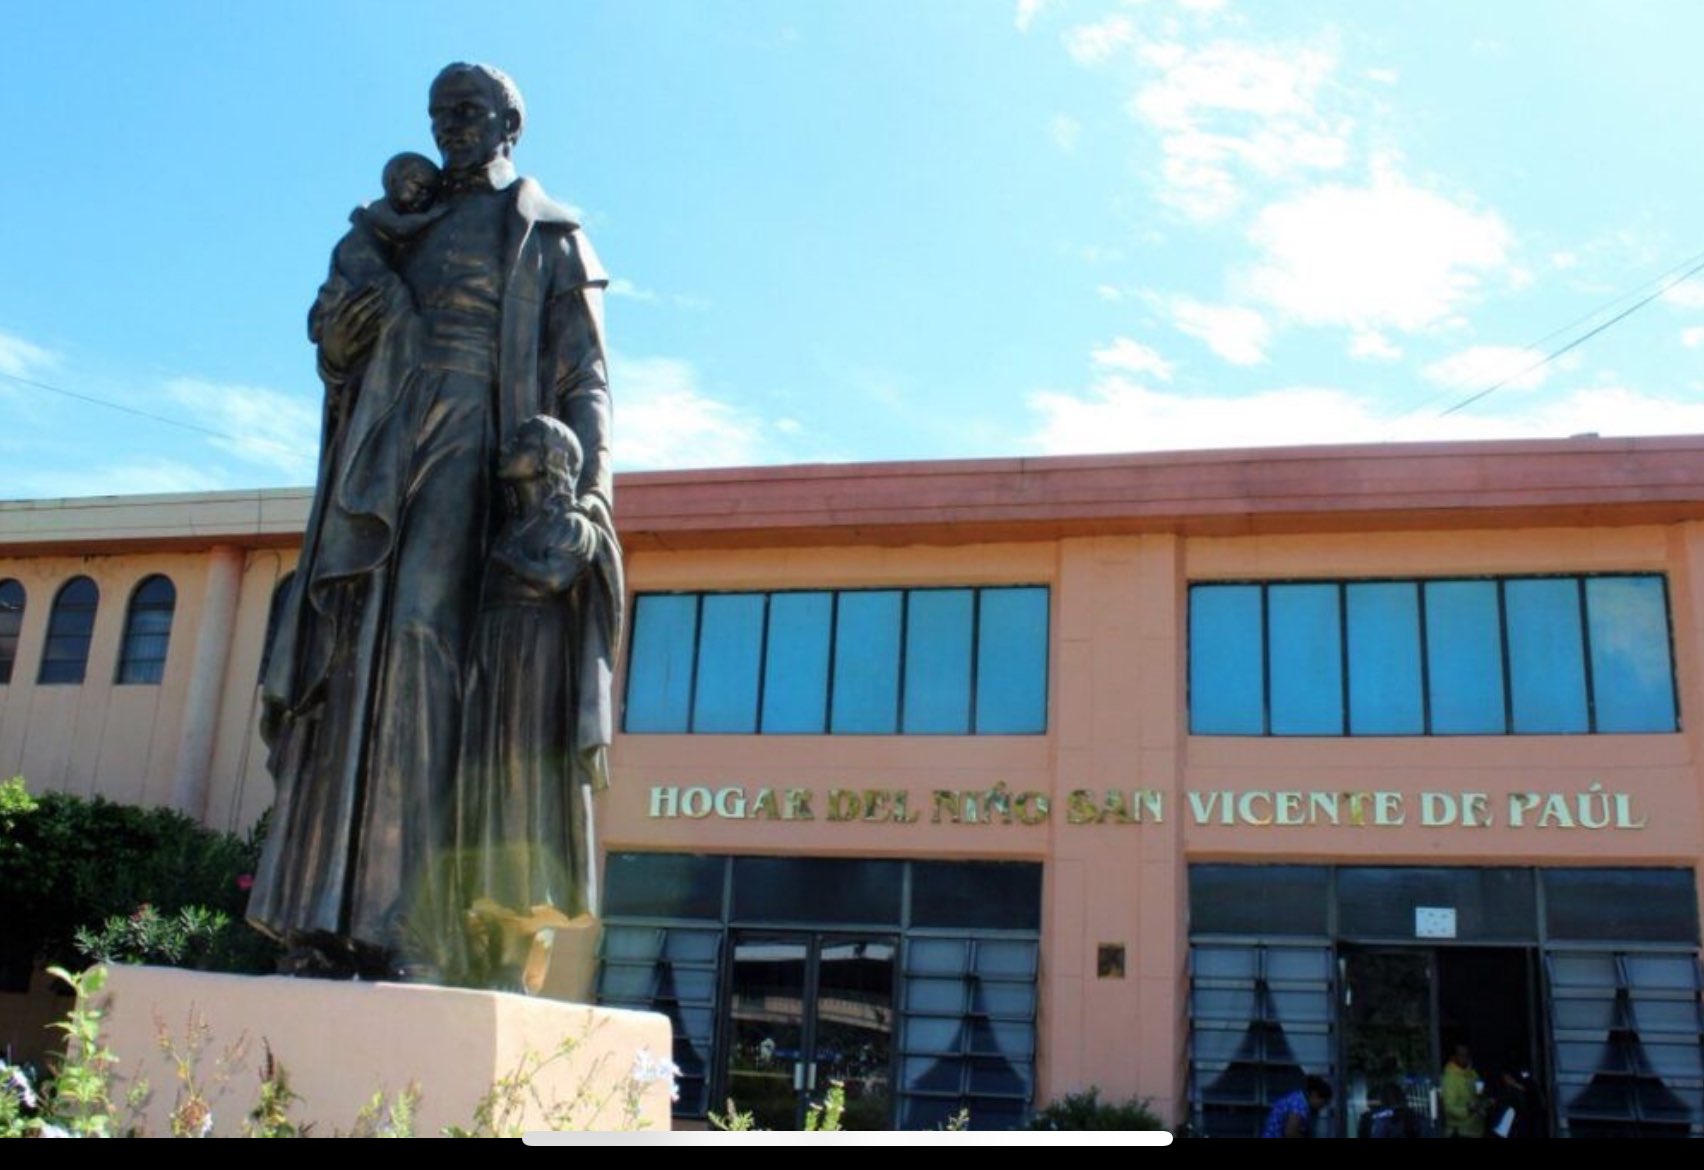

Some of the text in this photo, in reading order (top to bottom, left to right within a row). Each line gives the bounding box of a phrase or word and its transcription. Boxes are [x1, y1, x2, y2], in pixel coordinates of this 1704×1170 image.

[649, 781, 1647, 831] HOGAR DEL NIÑO SAN VICENTE DE PAÚL
